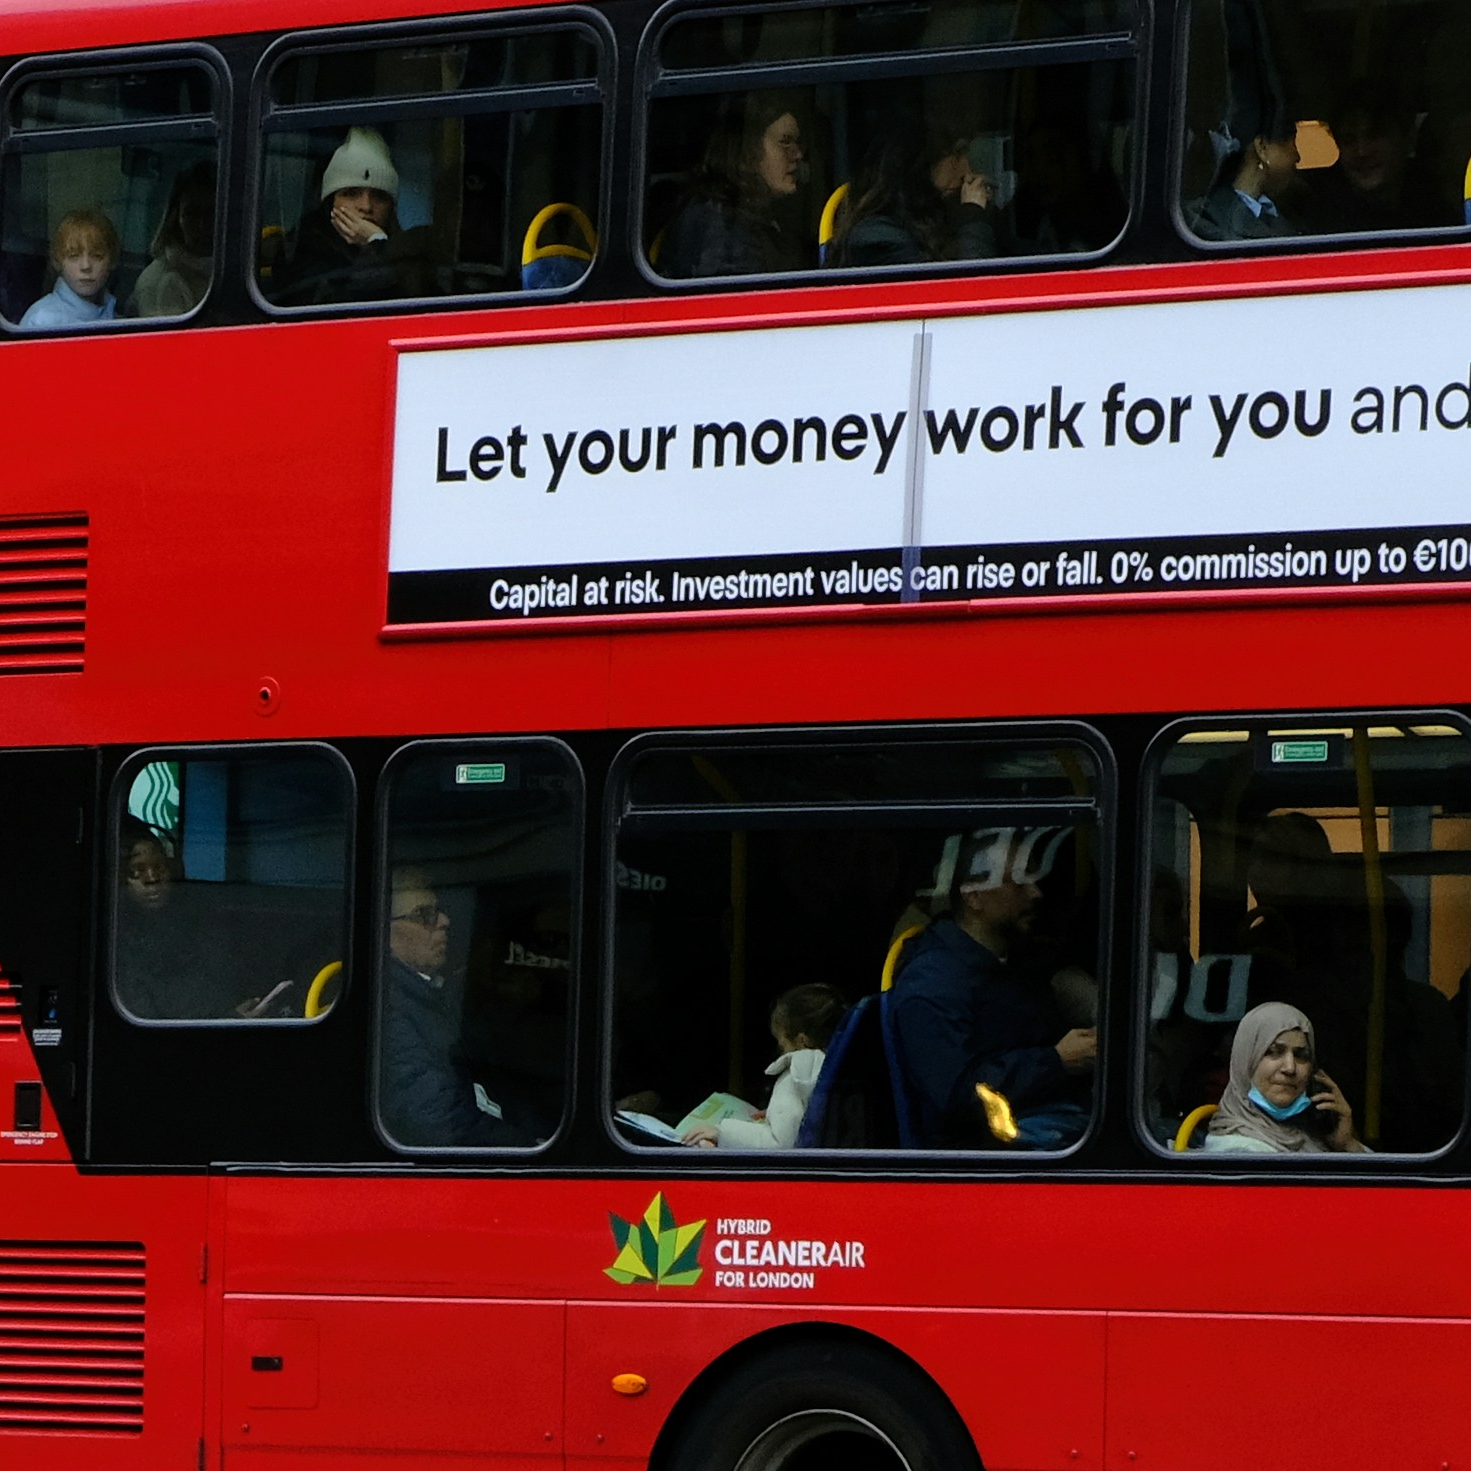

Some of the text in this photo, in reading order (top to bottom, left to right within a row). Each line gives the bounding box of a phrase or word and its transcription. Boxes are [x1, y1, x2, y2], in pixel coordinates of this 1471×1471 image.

[436, 363, 1471, 493] Let your money work for you and
[490, 575, 578, 615] Capital
[584, 576, 609, 605] at
[614, 570, 665, 605] risk.
[672, 565, 814, 602] Investment
[821, 561, 902, 595] values
[910, 561, 959, 591] can
[966, 555, 1015, 589] rise
[1022, 558, 1050, 587] or
[1057, 550, 1103, 586] fall.
[1110, 550, 1153, 583] 0%
[1160, 542, 1327, 581] commission
[1334, 547, 1371, 582] up
[1378, 542, 1407, 574] to
[716, 1218, 772, 1235] HYBRID
[715, 1271, 815, 1288] FOR LONDON
